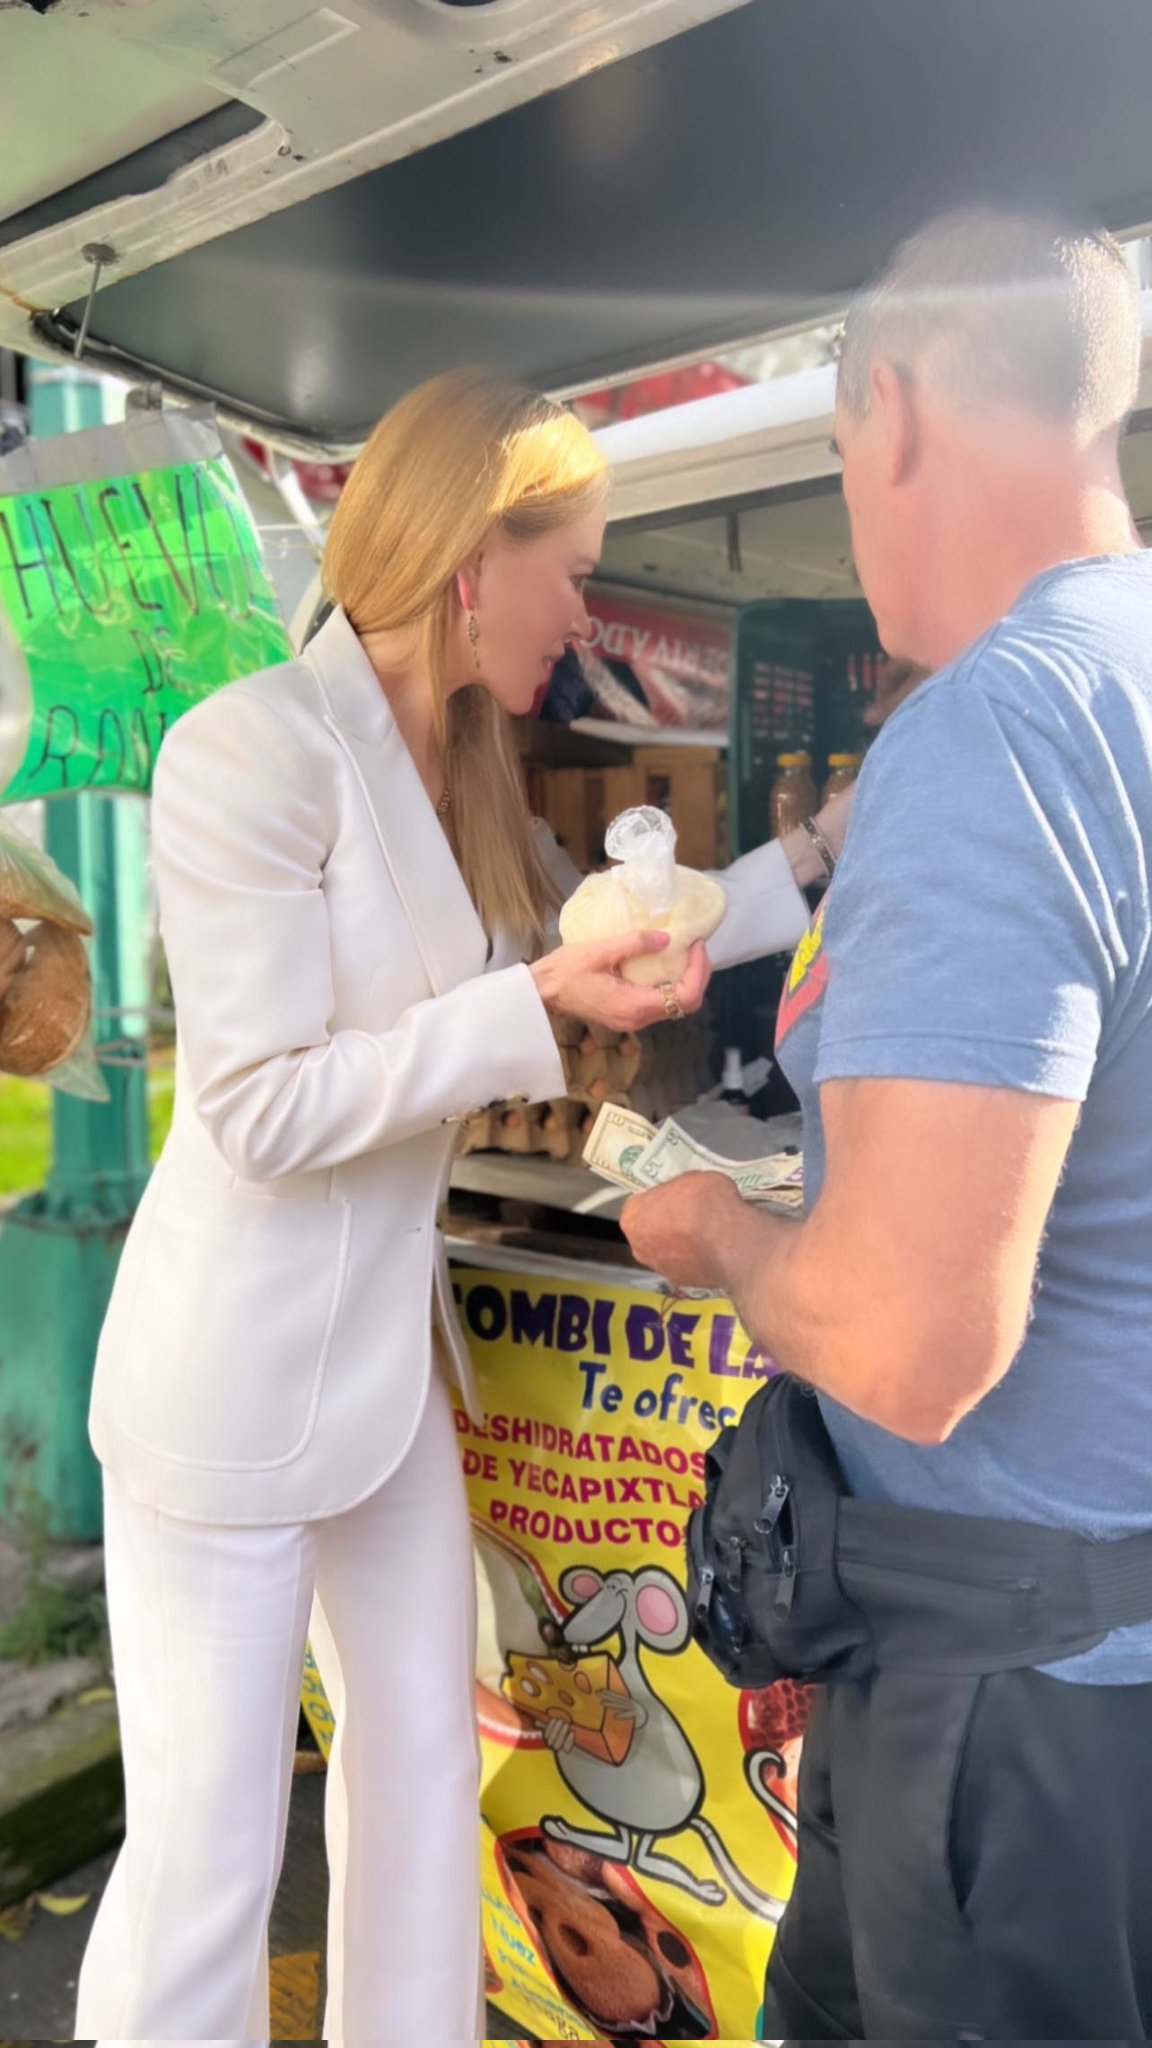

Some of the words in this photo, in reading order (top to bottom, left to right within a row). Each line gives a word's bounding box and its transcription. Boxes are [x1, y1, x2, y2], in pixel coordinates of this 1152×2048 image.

[625, 1304, 701, 1369] DE
[579, 1360, 623, 1413] Te
[463, 1449, 498, 1481] DE
[489, 1499, 687, 1548] PRODUCTO
